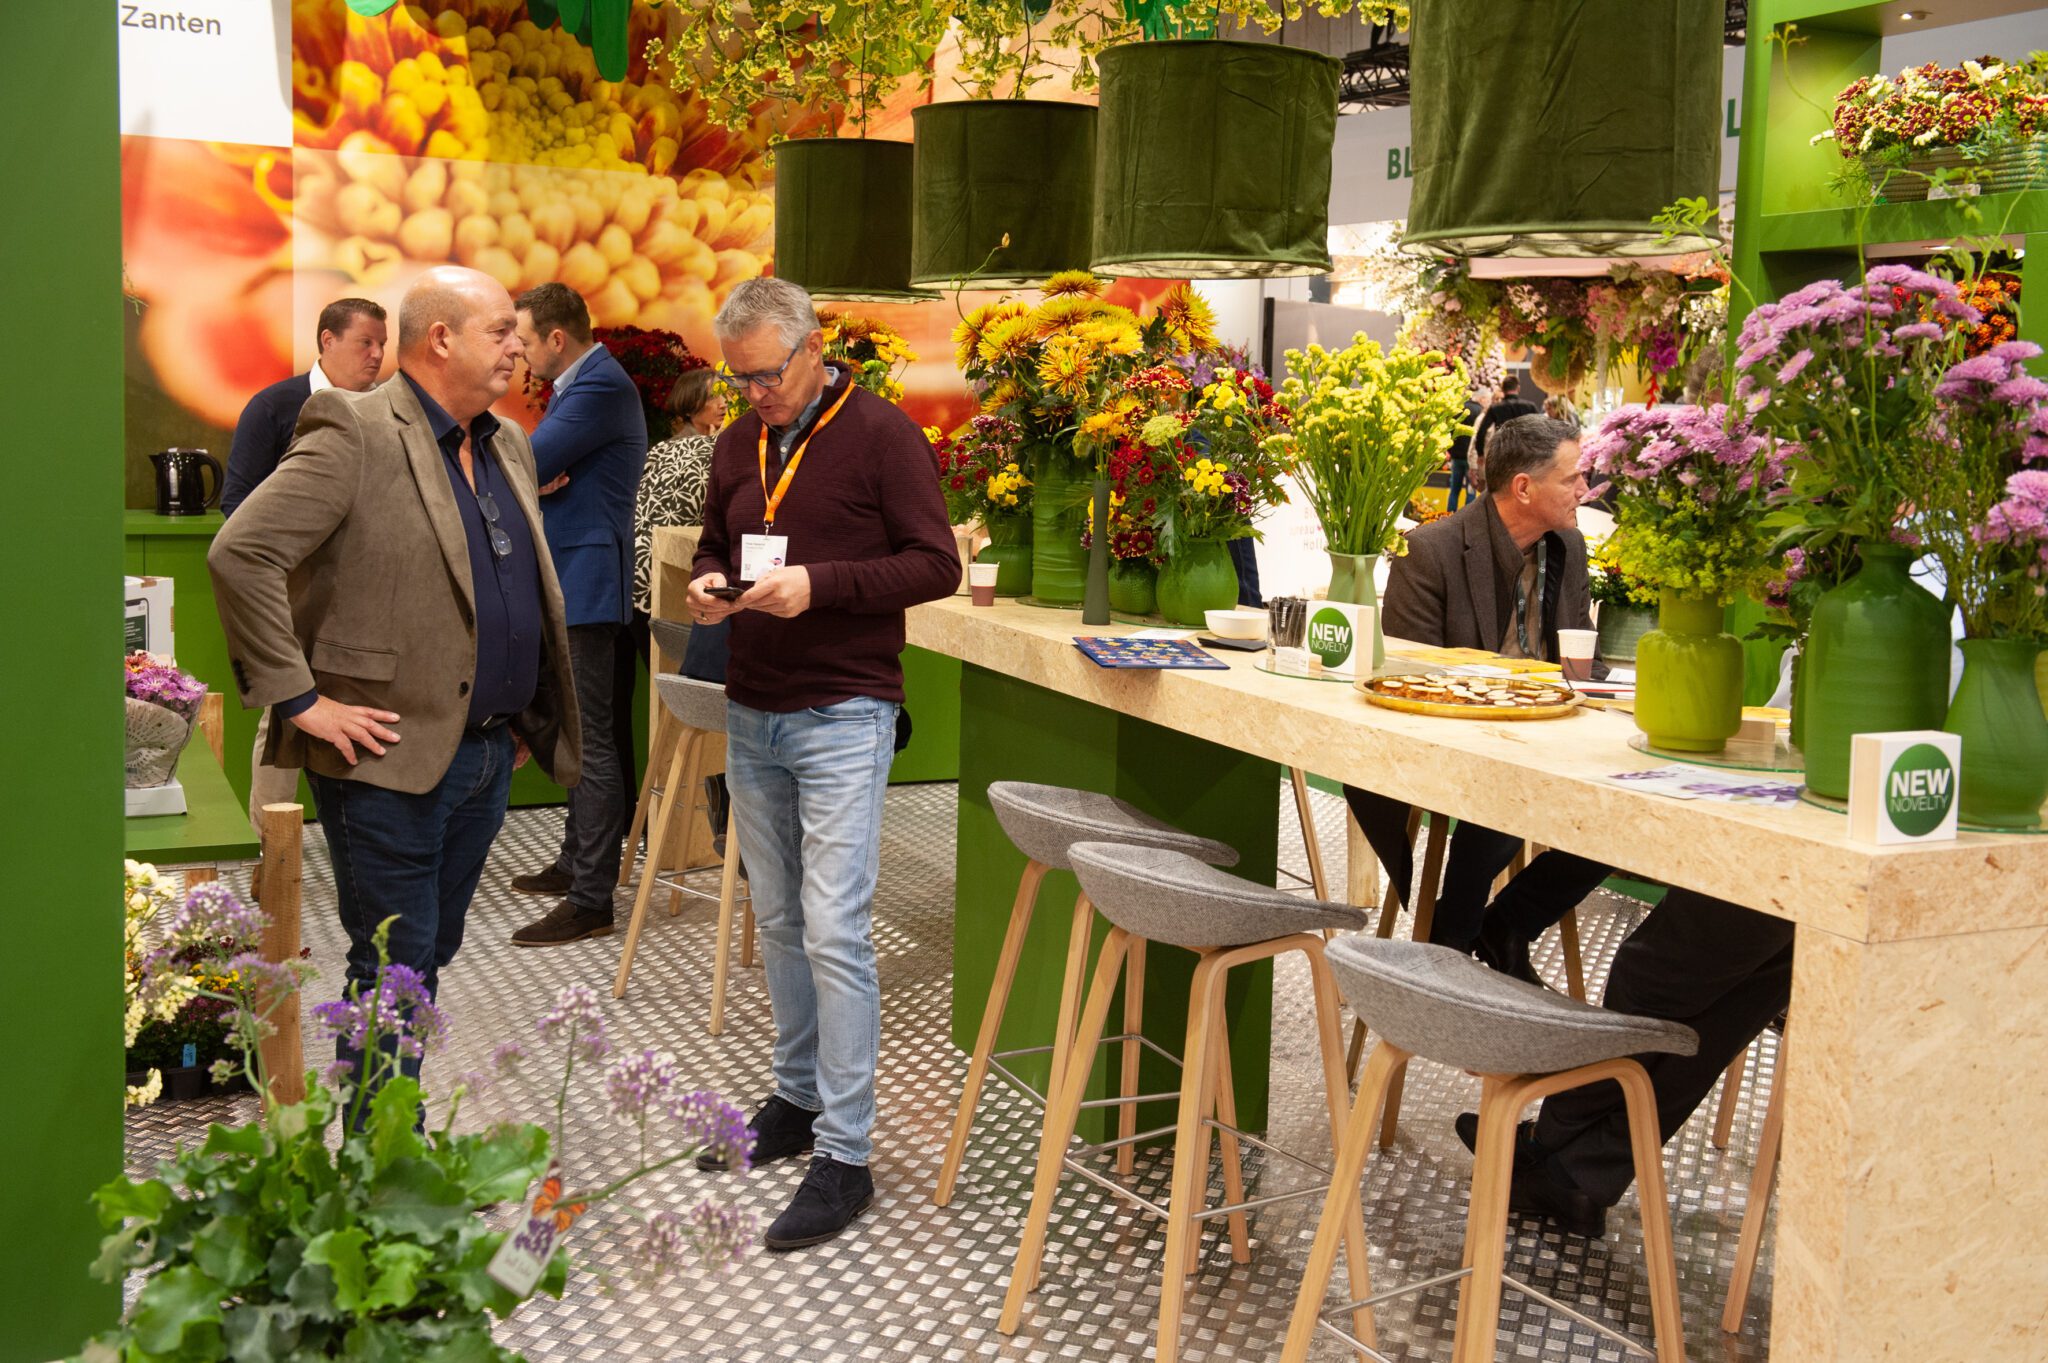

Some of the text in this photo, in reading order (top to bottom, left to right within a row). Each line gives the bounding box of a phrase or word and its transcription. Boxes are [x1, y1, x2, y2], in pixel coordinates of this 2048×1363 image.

[121, 5, 221, 35] Zanten
[1311, 622, 1350, 643] NEW
[1311, 639, 1349, 653] NOVELTY
[1891, 768, 1950, 797] NEW
[1890, 795, 1949, 813] NOVELTY
